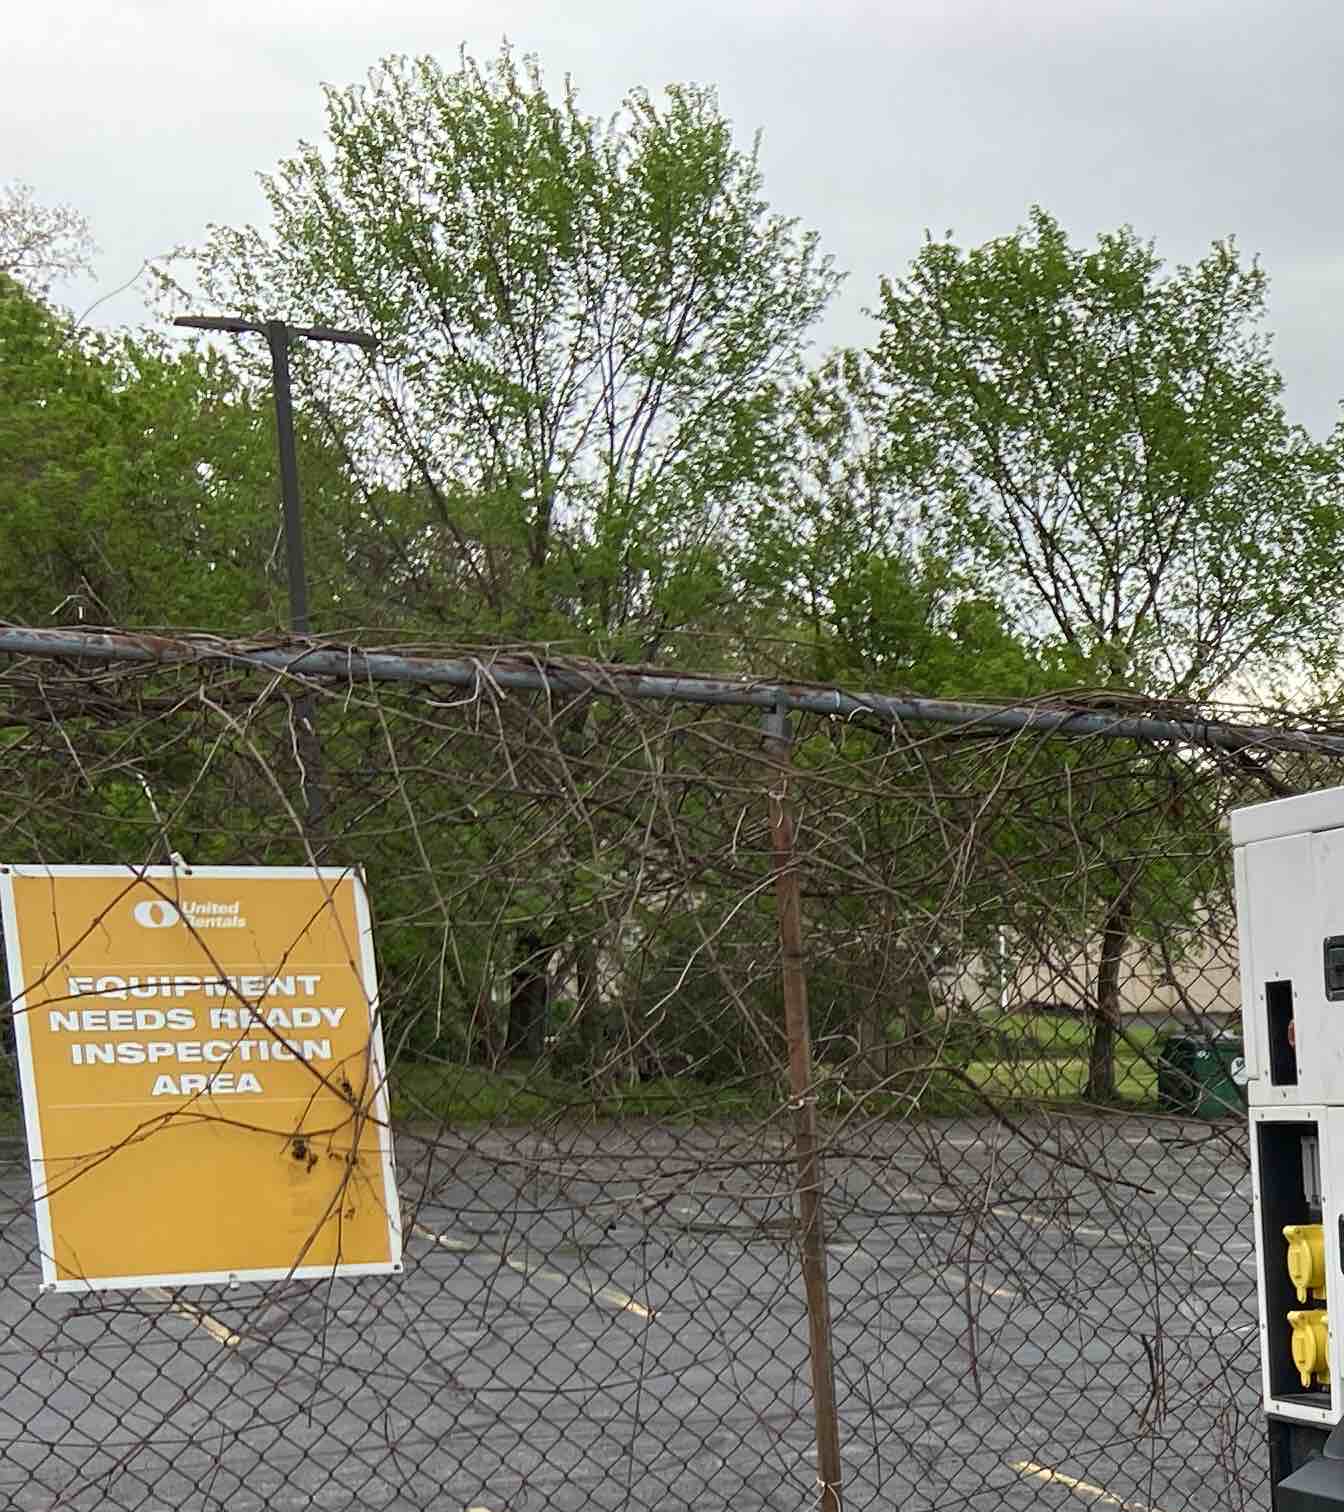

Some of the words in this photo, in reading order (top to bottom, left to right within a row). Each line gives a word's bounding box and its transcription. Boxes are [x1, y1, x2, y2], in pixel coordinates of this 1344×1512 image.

[182, 901, 240, 914] United
[67, 975, 321, 1000] EQUIPMENT
[49, 1008, 196, 1032] NEEDS
[209, 1007, 346, 1030] READY
[71, 1039, 333, 1065] INSPECTION
[151, 1072, 263, 1096] AREA
